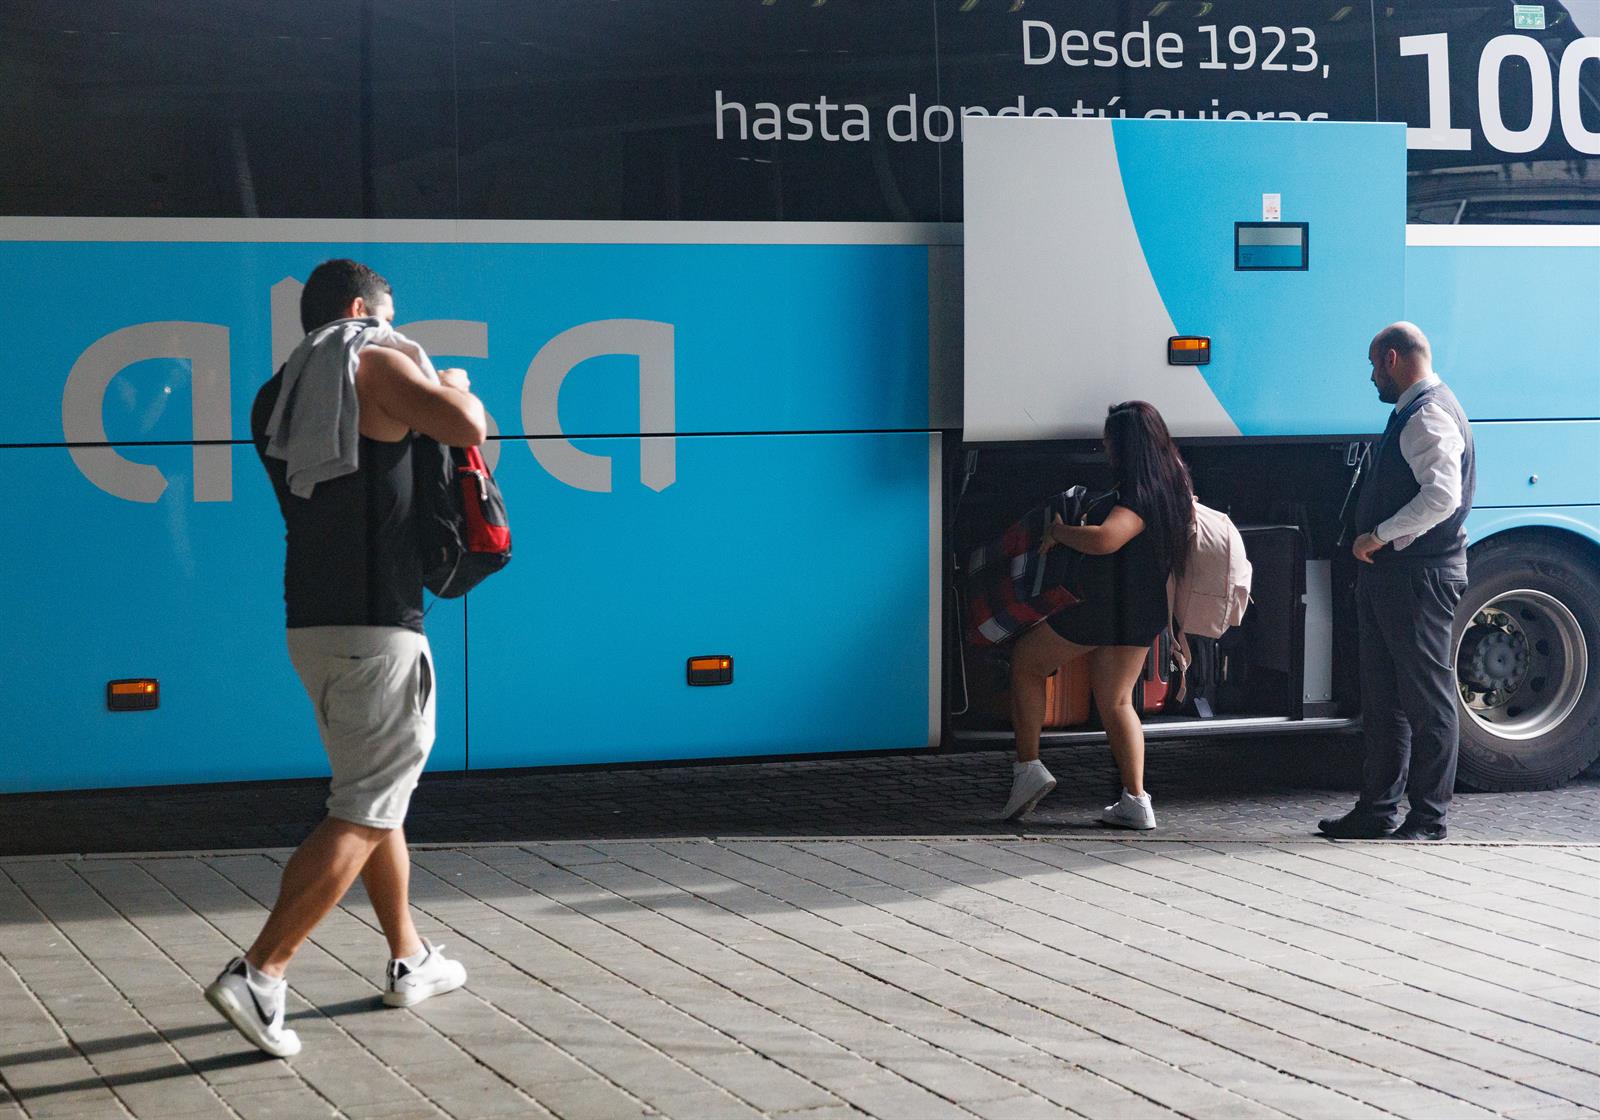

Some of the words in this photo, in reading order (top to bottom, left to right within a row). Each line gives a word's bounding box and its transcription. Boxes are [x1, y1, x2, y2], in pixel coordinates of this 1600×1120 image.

[1022, 20, 1184, 69] Desde
[1198, 24, 1330, 79] 1923,
[715, 90, 870, 142] hasta
[887, 93, 1060, 143] dod
[1400, 33, 1600, 155] 100
